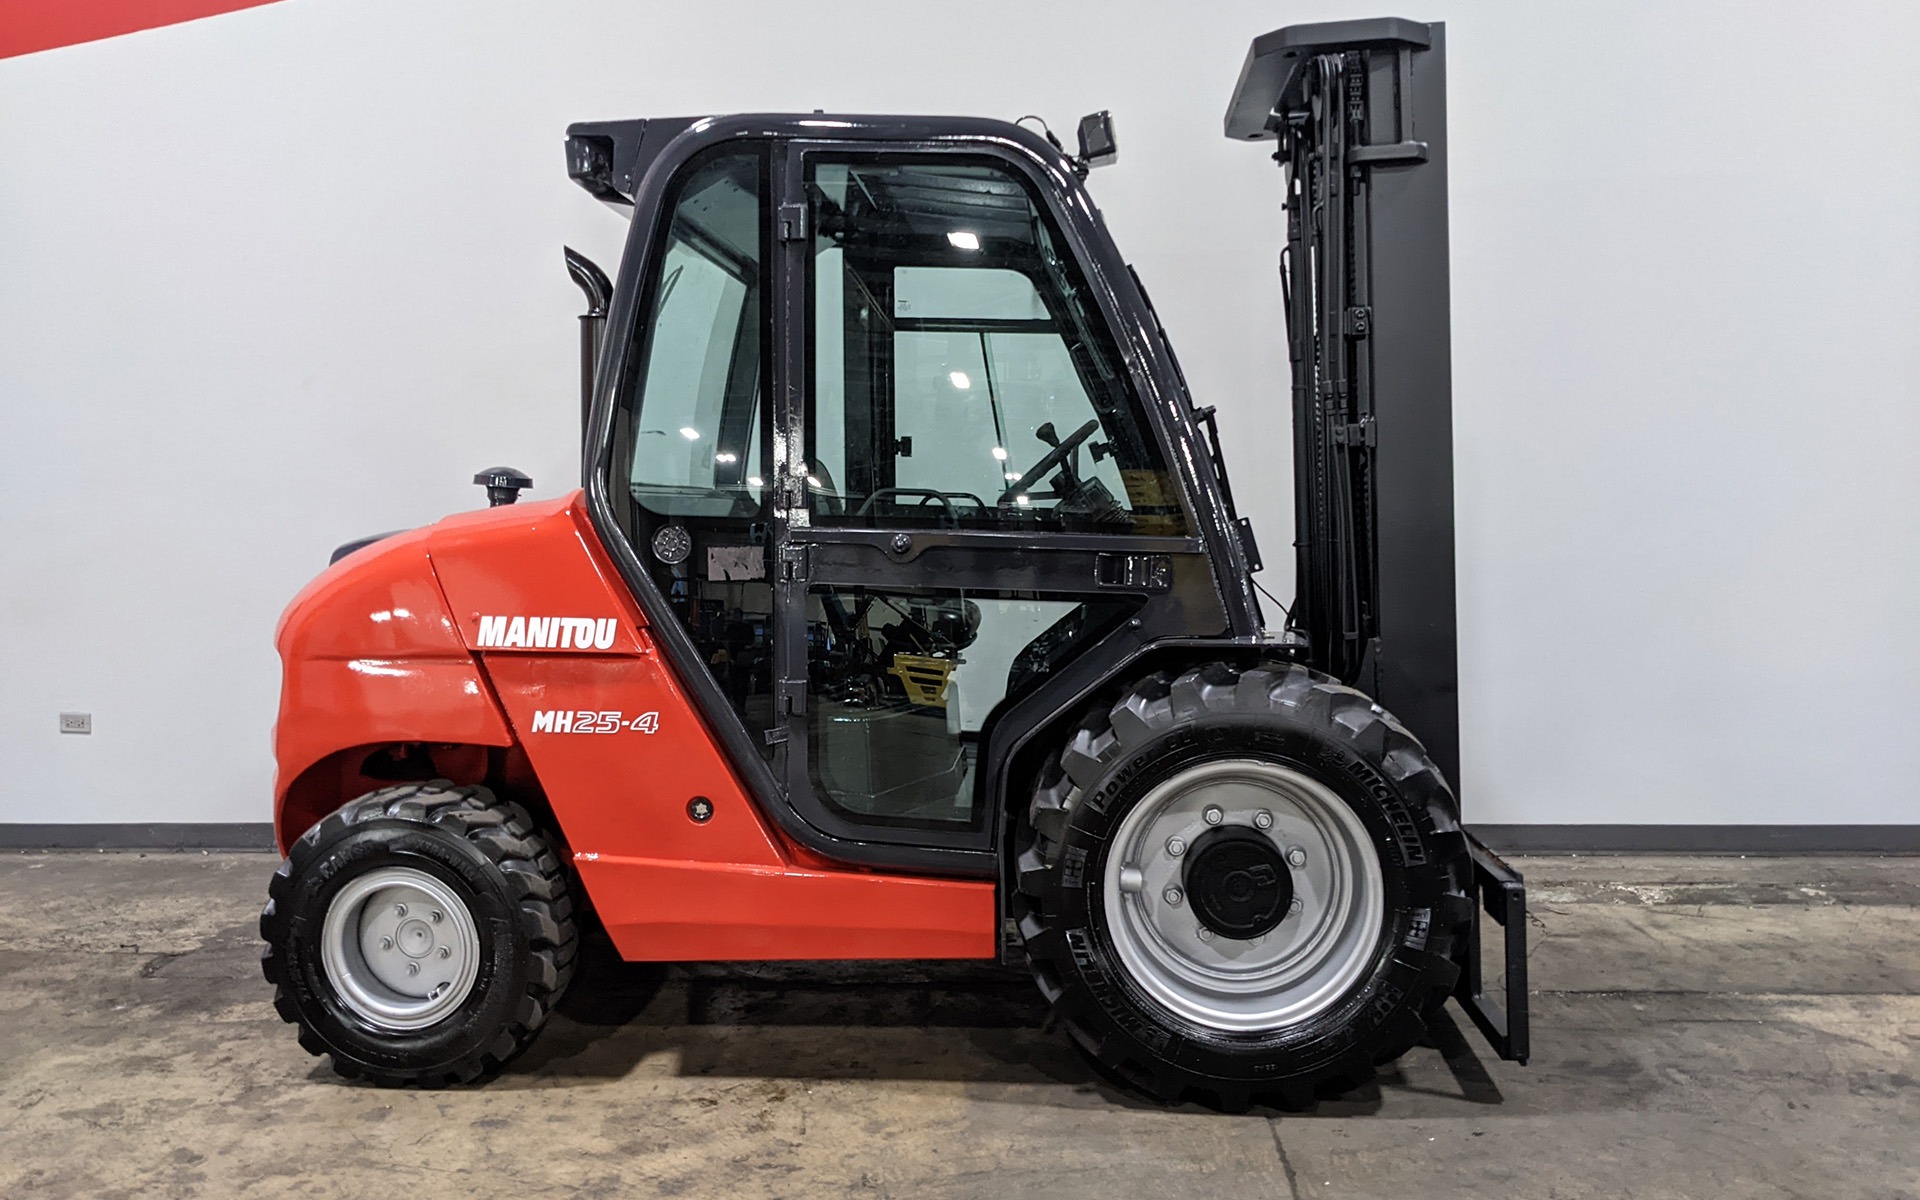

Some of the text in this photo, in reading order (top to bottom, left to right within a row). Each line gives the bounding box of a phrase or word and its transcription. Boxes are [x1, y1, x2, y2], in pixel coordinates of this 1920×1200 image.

[476, 616, 618, 650] MANITOU
[531, 710, 660, 735] MH25-4
[1090, 747, 1160, 810] Power
[1346, 760, 1425, 863] MICHELIN
